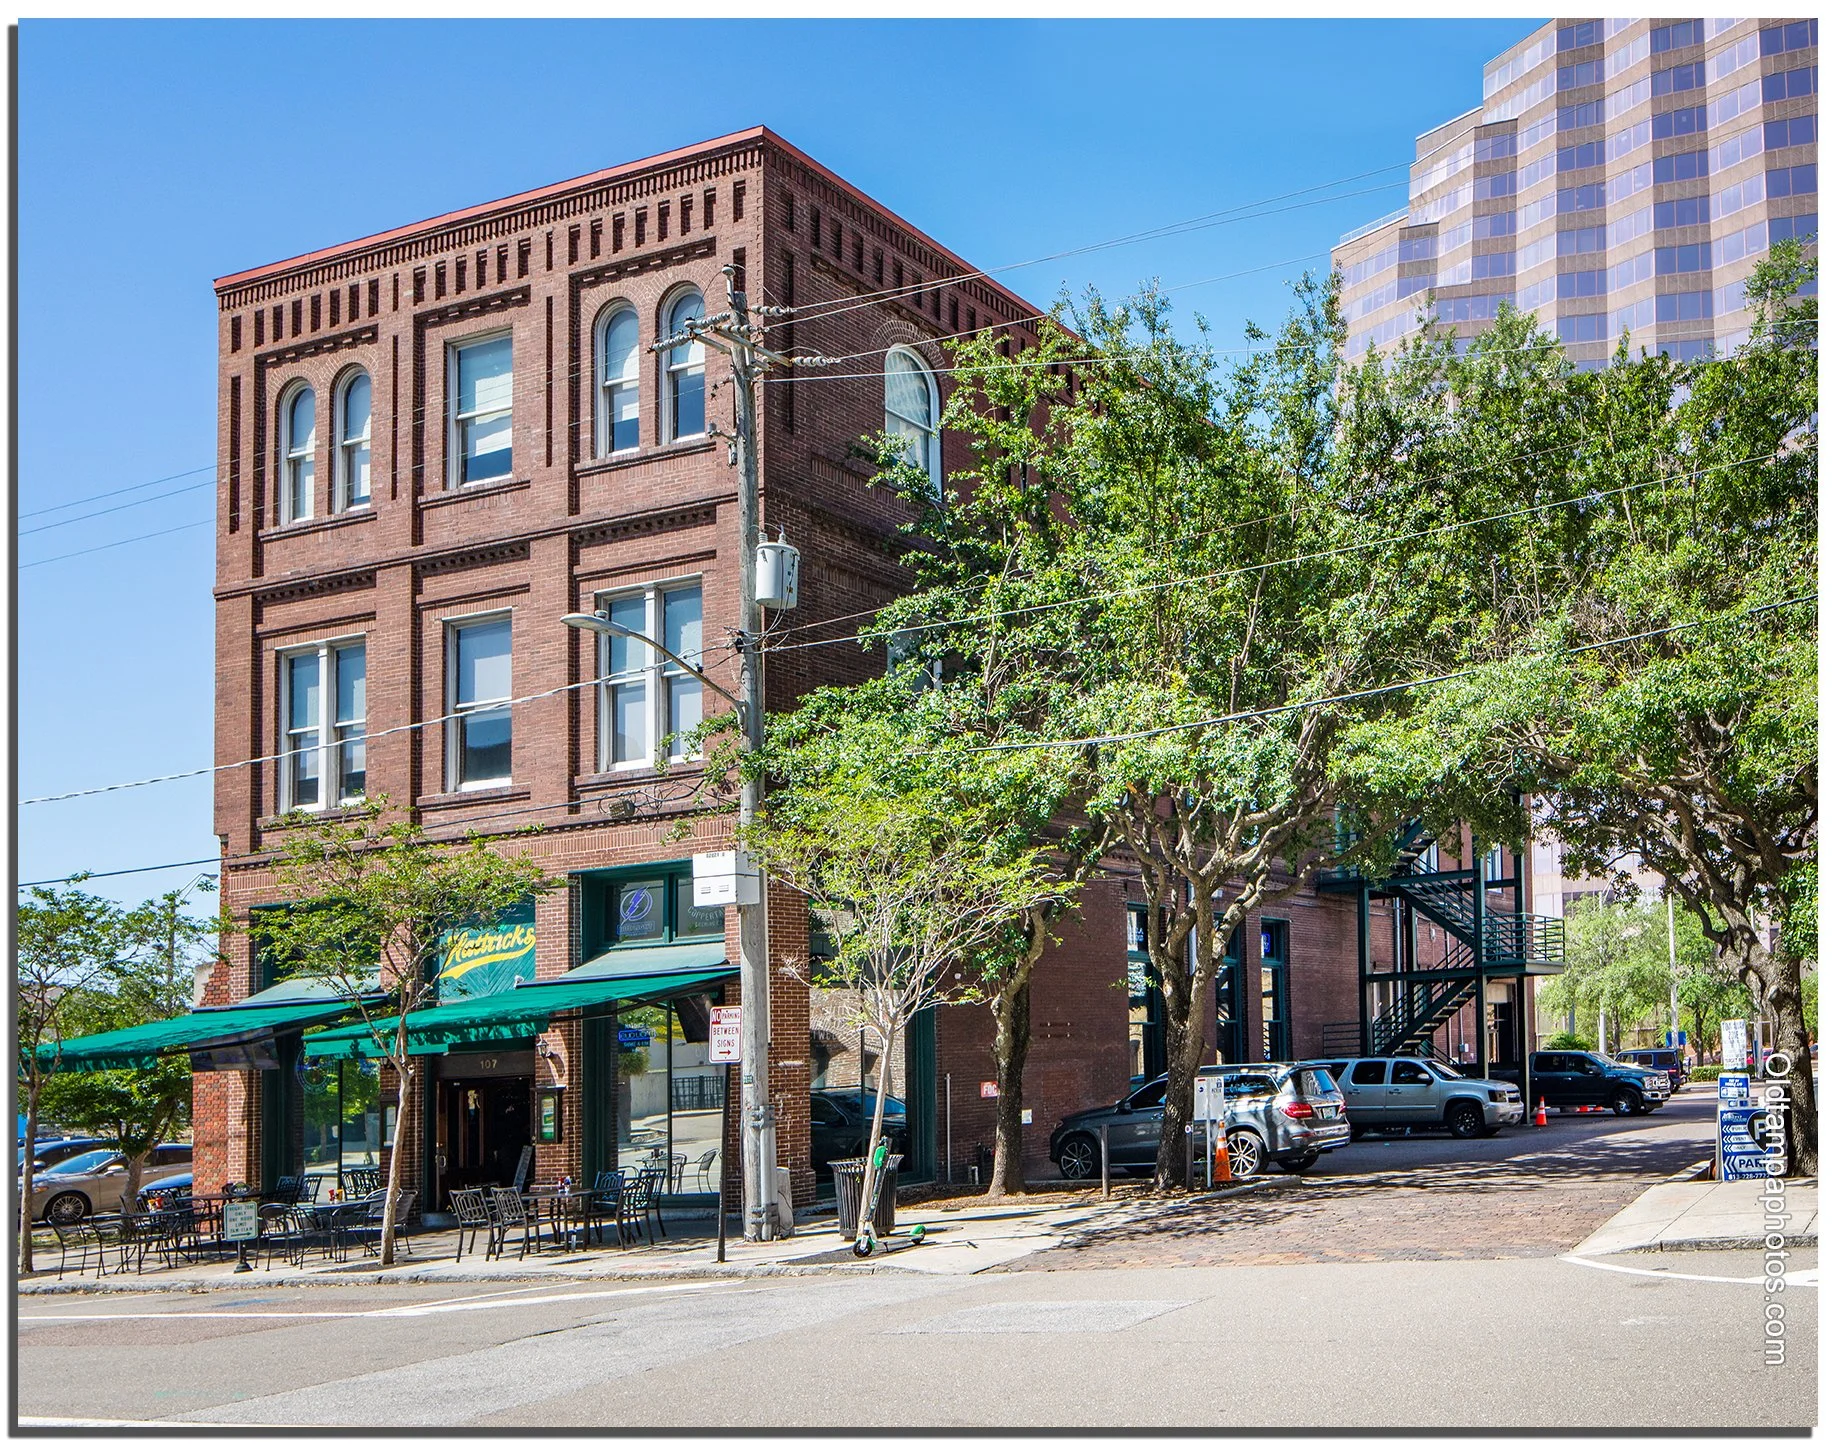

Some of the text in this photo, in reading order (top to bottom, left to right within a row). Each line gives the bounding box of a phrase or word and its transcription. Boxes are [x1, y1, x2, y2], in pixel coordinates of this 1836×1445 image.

[444, 924, 536, 968] Hattricks
[711, 1010, 721, 1022] NO
[712, 1027, 739, 1036] BETWEEN
[717, 1039, 735, 1048] SIGNS
[480, 1059, 497, 1069] 107
[1754, 1119, 1768, 1140] P
